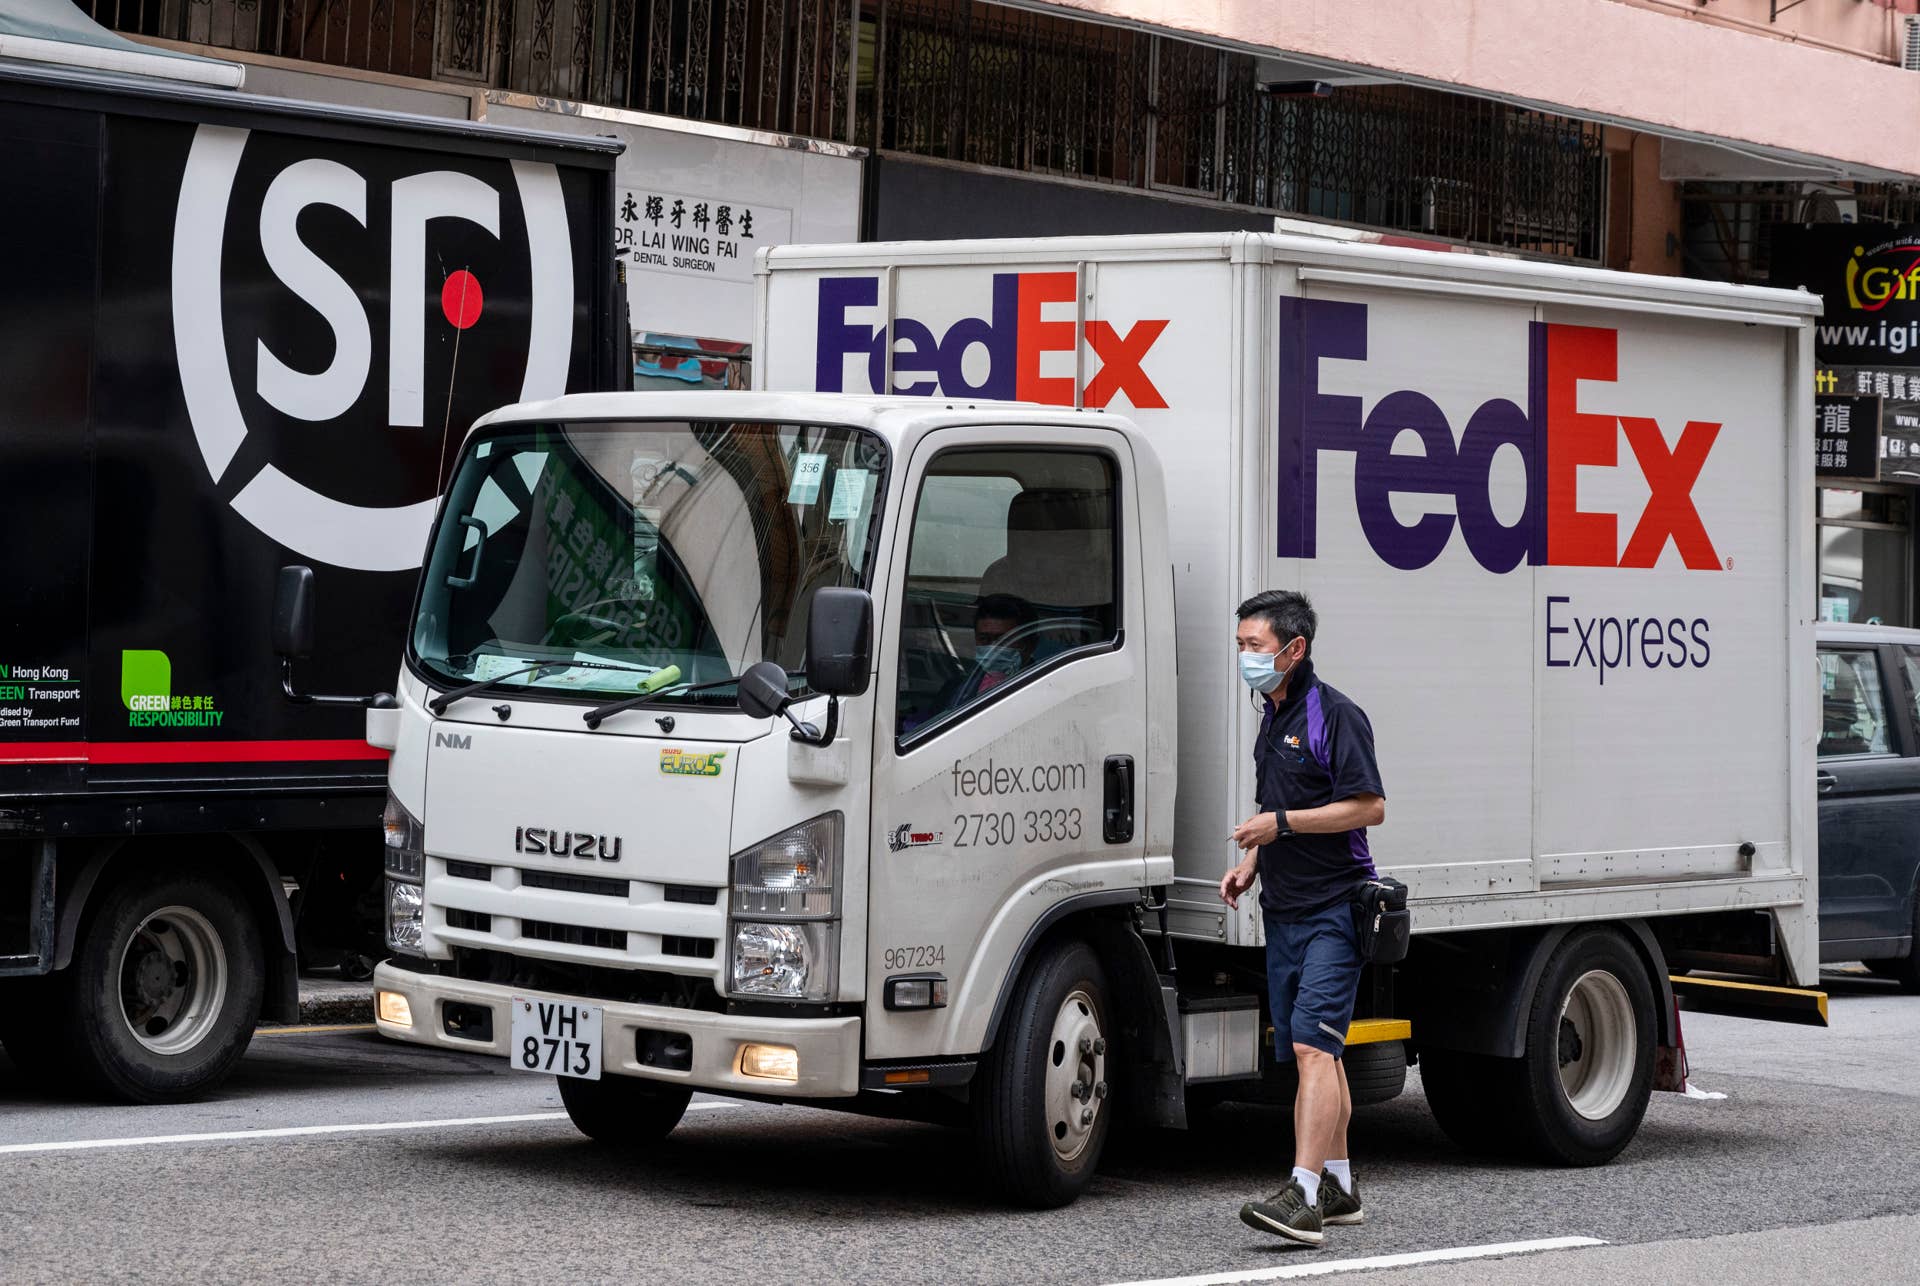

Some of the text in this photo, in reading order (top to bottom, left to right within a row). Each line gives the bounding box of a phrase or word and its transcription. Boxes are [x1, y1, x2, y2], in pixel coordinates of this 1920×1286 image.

[620, 192, 754, 239] 永輝牙科醫生
[615, 227, 738, 259] DR. LAI WING FAI
[633, 251, 715, 272] DENTAL SURGEON
[815, 272, 1171, 410] FedEx
[1815, 320, 1920, 354] ww.igi
[1277, 295, 1723, 574] FedEx
[800, 463, 820, 473] 356
[1547, 596, 1710, 685] Express
[13, 666, 39, 680] Hong
[42, 666, 69, 680] Kong
[28, 688, 80, 702] Transport
[130, 695, 170, 711] GREEN
[23, 707, 32, 717] by
[23, 718, 59, 728] Transport
[61, 717, 80, 726] Fund
[129, 711, 223, 727] RESPONSIBILITY
[435, 732, 472, 750] NM
[952, 759, 1085, 797] fedex.com
[954, 808, 1082, 847] 2730 3333
[515, 826, 623, 862] ISUZU
[884, 944, 945, 970] 967234
[538, 1002, 577, 1039] VH
[522, 1036, 591, 1075] 8713
